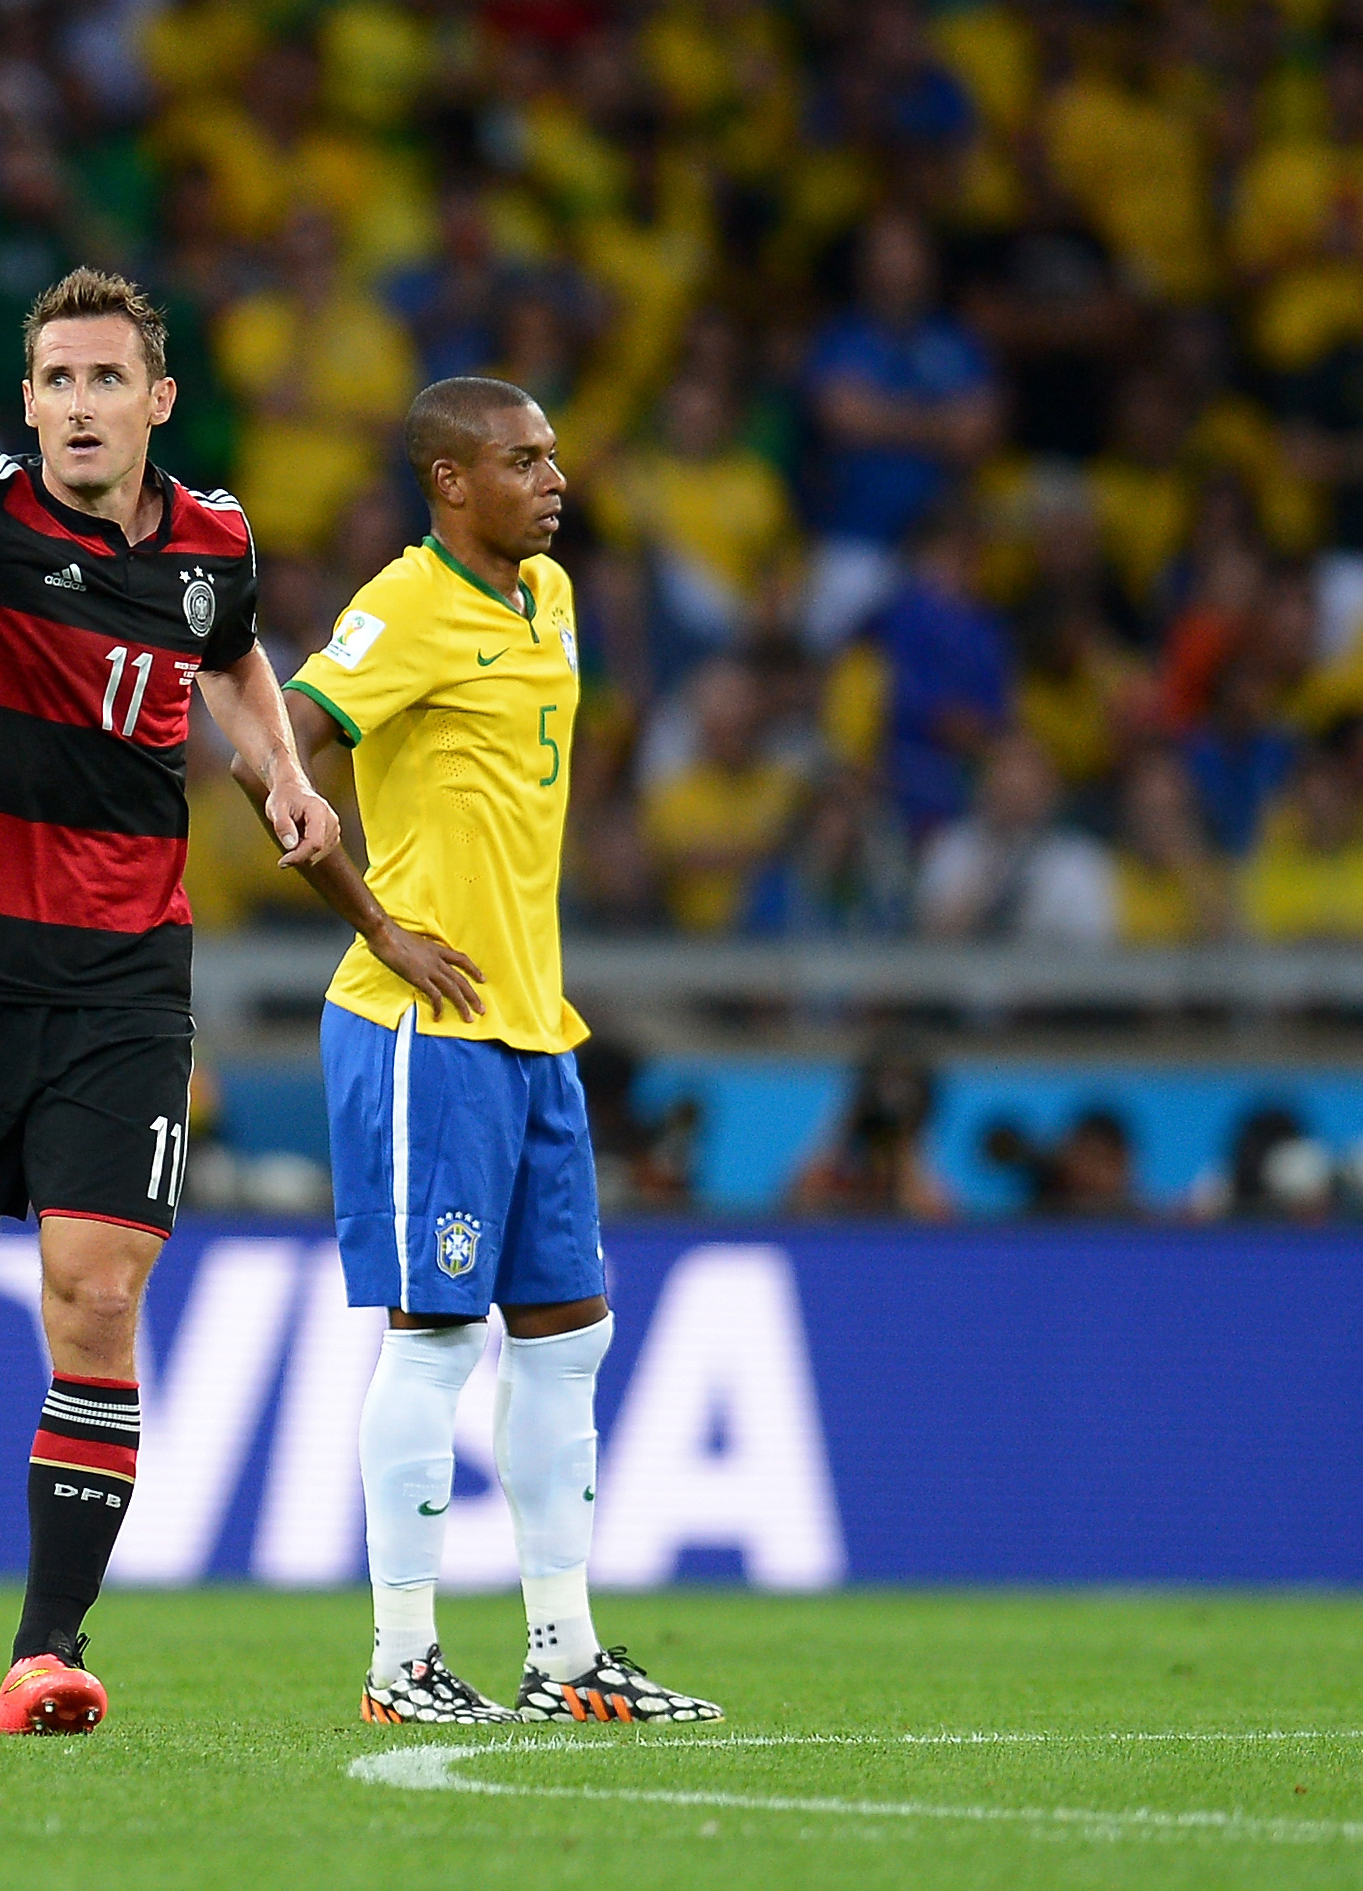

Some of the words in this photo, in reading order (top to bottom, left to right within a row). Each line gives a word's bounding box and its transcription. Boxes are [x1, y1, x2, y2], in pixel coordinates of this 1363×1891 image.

[44, 575, 87, 592] adidas
[101, 646, 153, 737] 11
[539, 705, 559, 787] 5
[148, 1116, 182, 1208] 11
[54, 1482, 122, 1509] DFB
